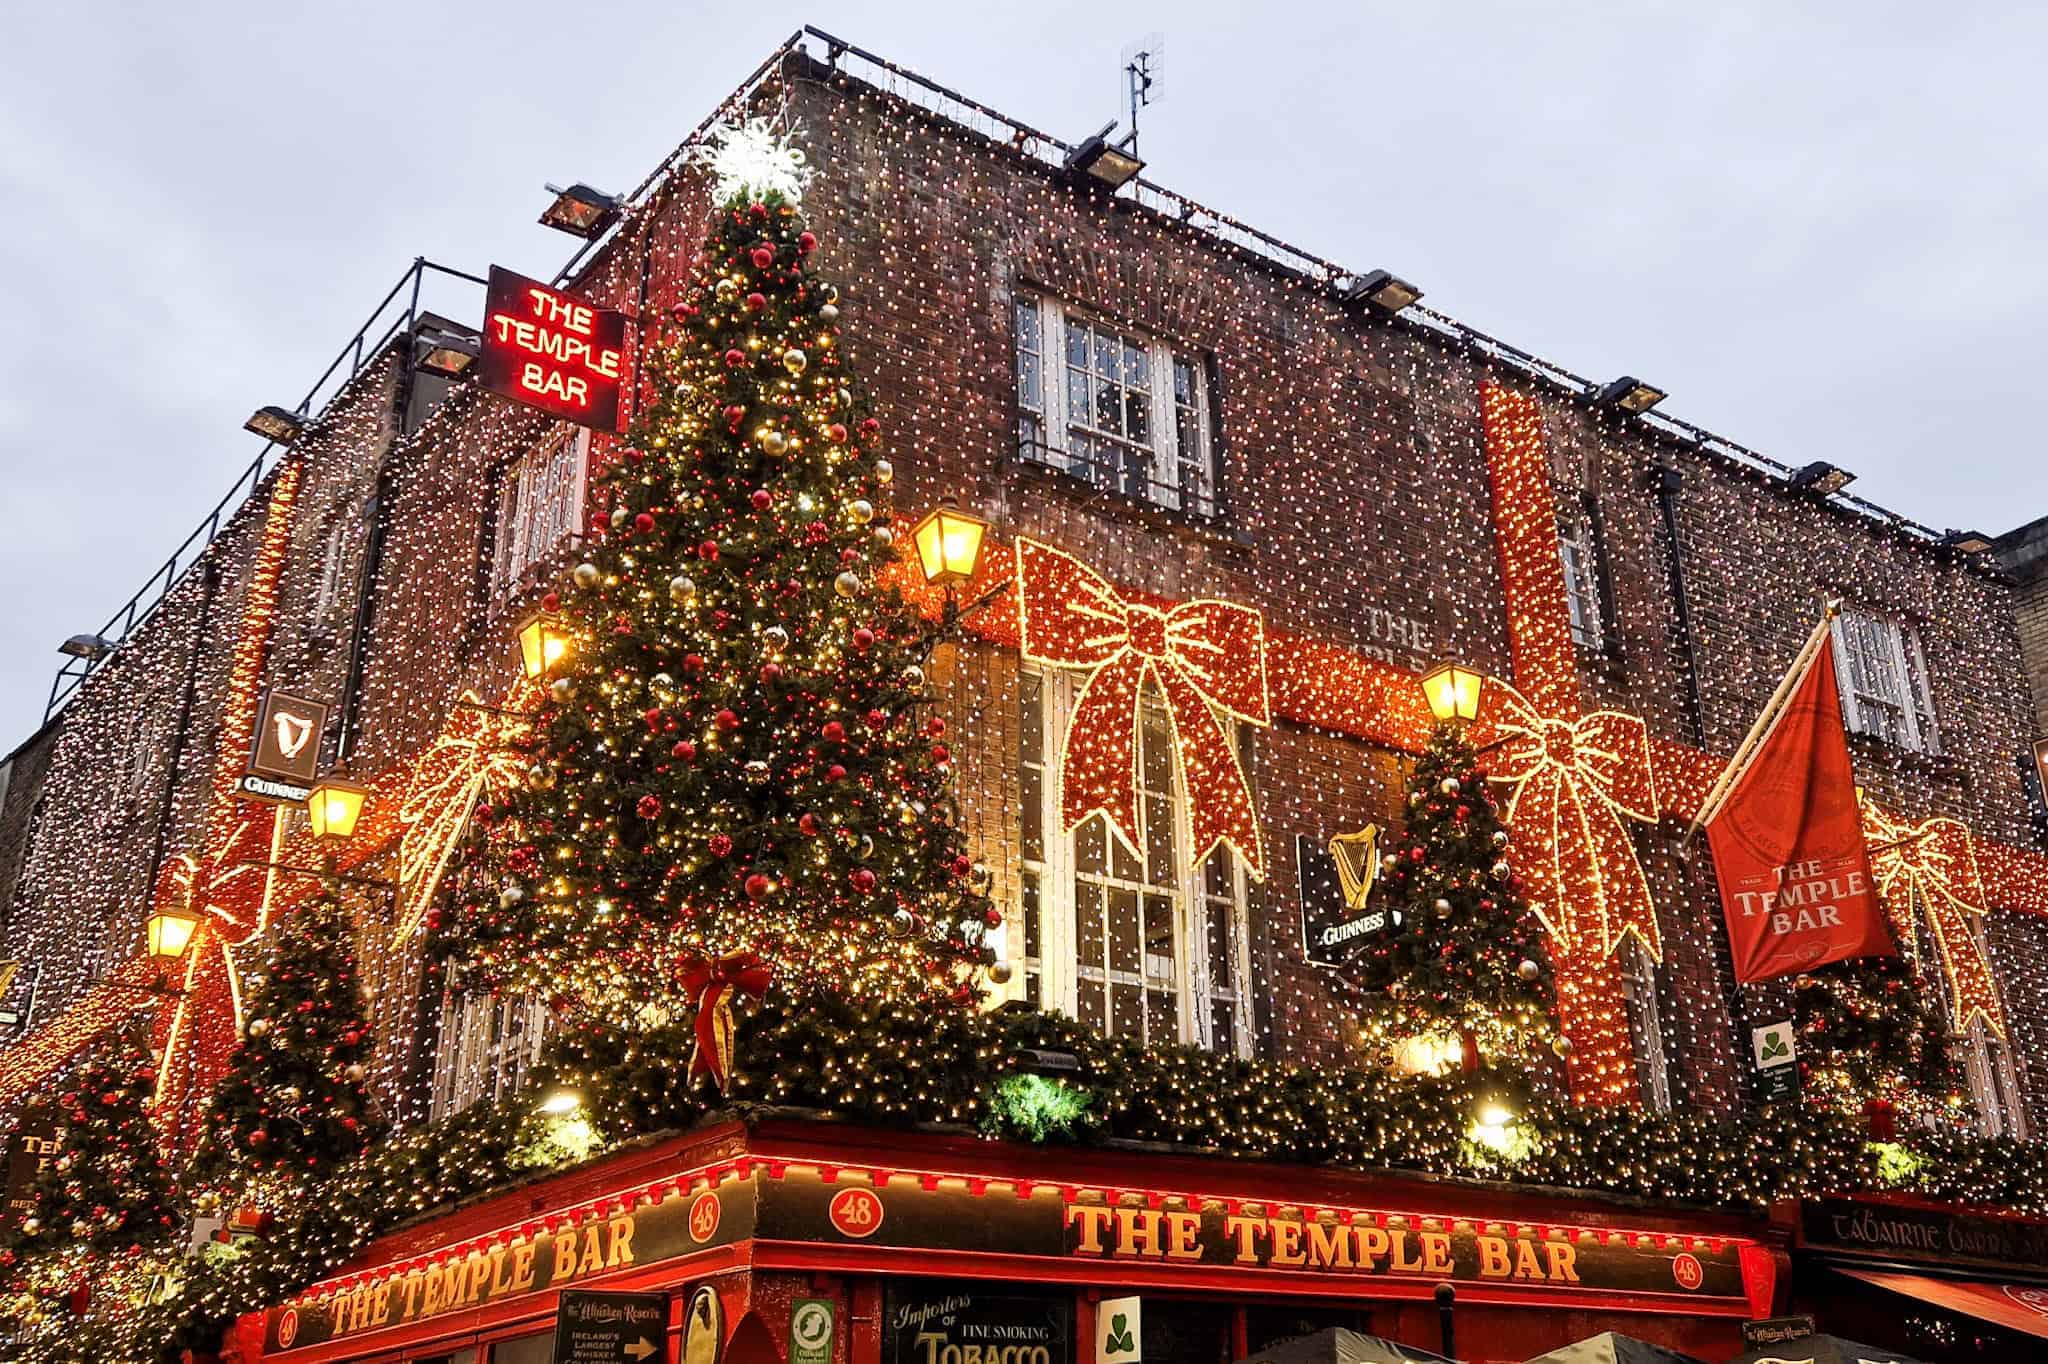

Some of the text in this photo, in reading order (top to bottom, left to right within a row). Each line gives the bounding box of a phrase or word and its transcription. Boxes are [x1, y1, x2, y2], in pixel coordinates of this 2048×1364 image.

[529, 289, 593, 335] THE
[494, 315, 620, 378] TEMPLE
[522, 363, 588, 406] BAR
[1362, 604, 1431, 653] THE
[1734, 871, 1868, 916] TEMPLE
[1772, 860, 1824, 884] THE
[1323, 911, 1385, 946] GUINNESS
[1773, 905, 1844, 935] BAR
[838, 1194, 1697, 1282] 48 THE TEMPLE BAR 48
[331, 1281, 392, 1336] THE
[401, 1240, 537, 1318] TEMPLE
[552, 1216, 636, 1281] BAR
[694, 1202, 714, 1233] 48
[962, 1324, 1049, 1340] FINE SMOKING
